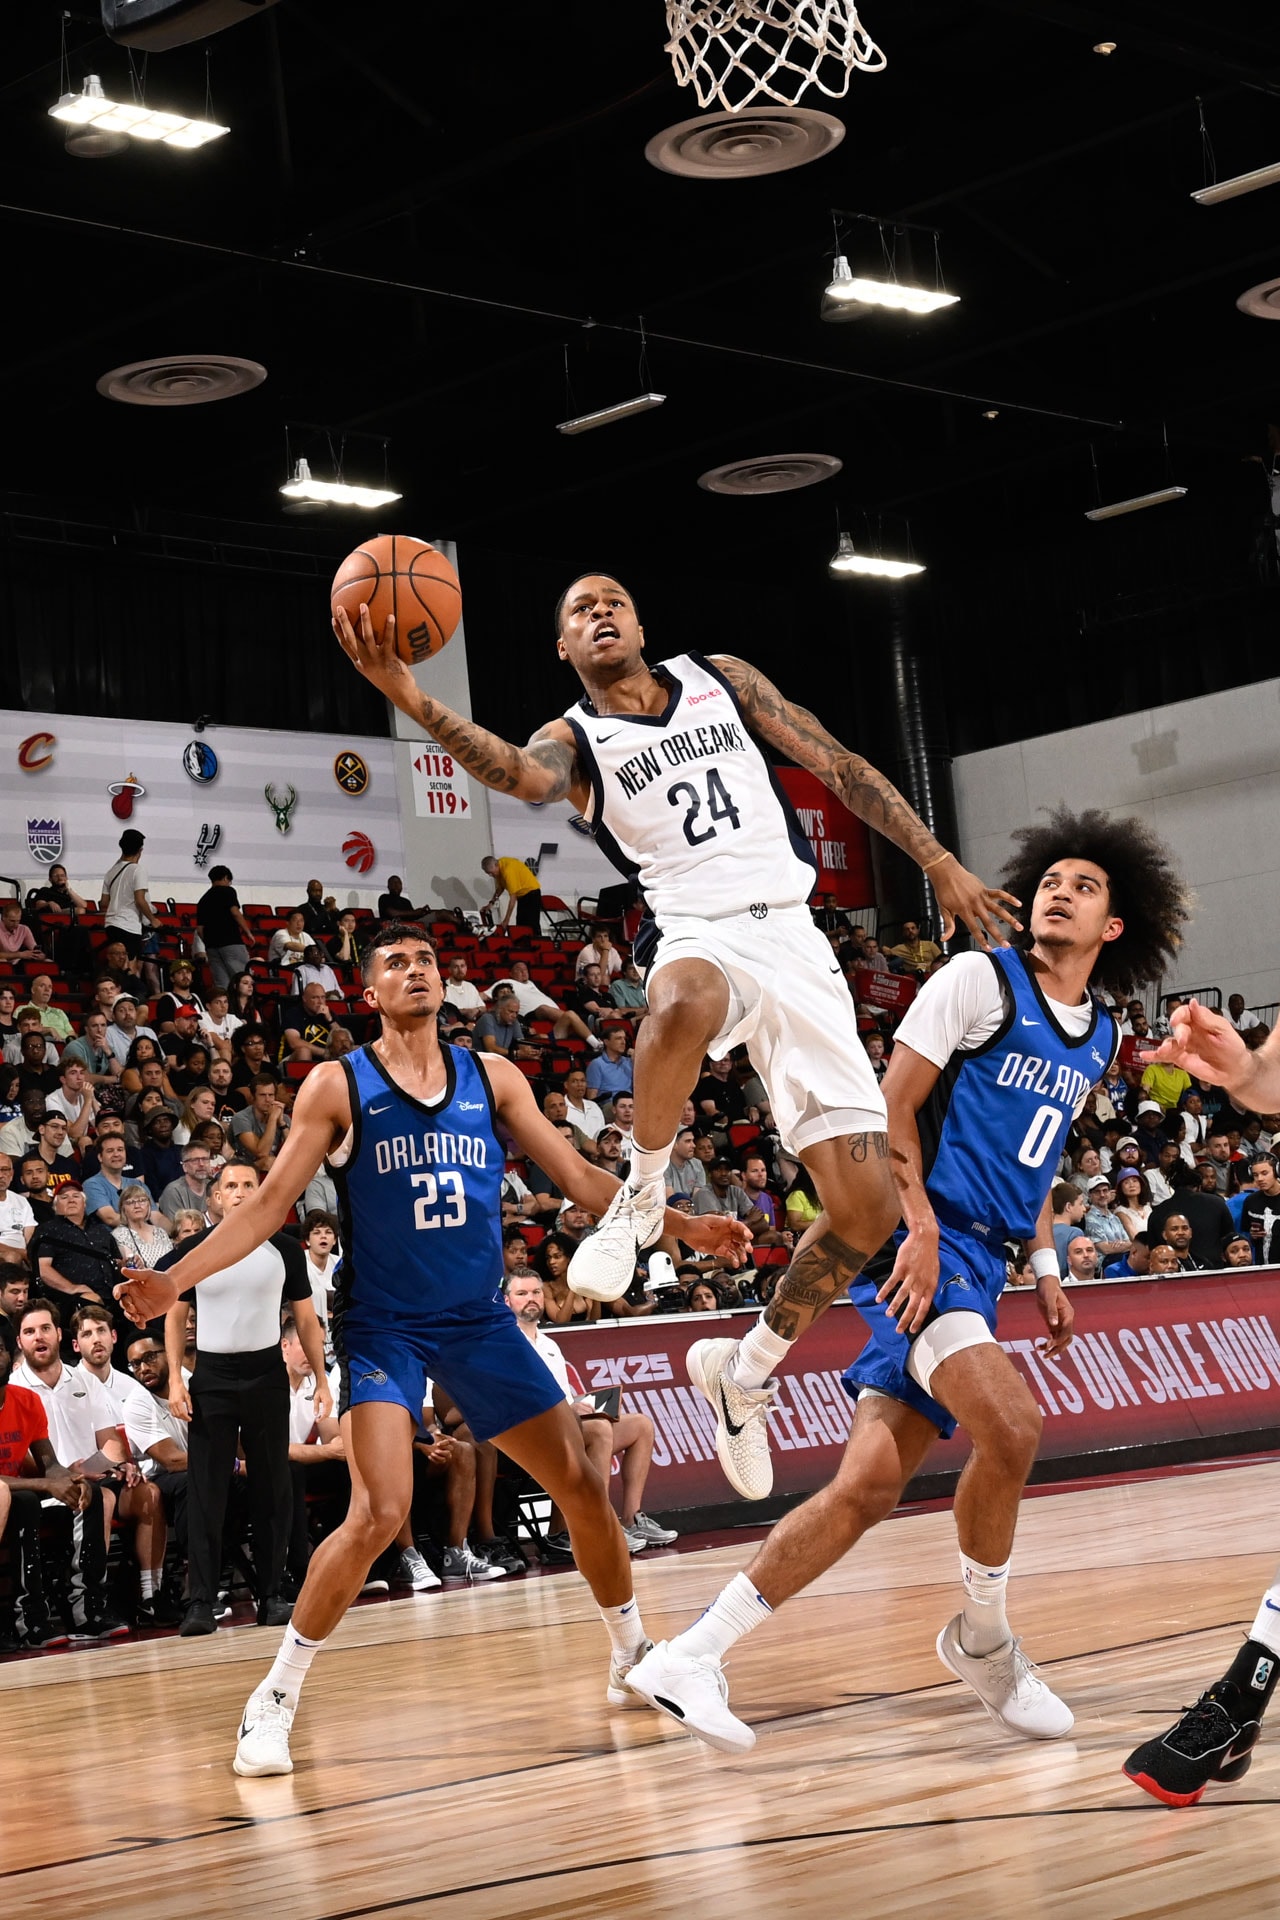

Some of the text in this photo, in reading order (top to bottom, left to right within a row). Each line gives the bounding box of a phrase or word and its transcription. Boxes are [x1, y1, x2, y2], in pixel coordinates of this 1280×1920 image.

[423, 754, 454, 777] 118
[614, 746, 663, 801] NEW
[660, 722, 747, 767] ORLEANS
[427, 791, 457, 814] 119
[429, 781, 452, 791] SECTION
[666, 767, 741, 847] 24
[28, 835, 61, 845] KINGS
[820, 840, 848, 870] HERE
[375, 1131, 487, 1175] ORLANDO
[1018, 1104, 1063, 1168] 0
[410, 1170, 467, 1231] 23
[585, 1352, 674, 1388] 2K25
[1066, 1331, 1142, 1411] ON
[1118, 1323, 1225, 1404] SALE
